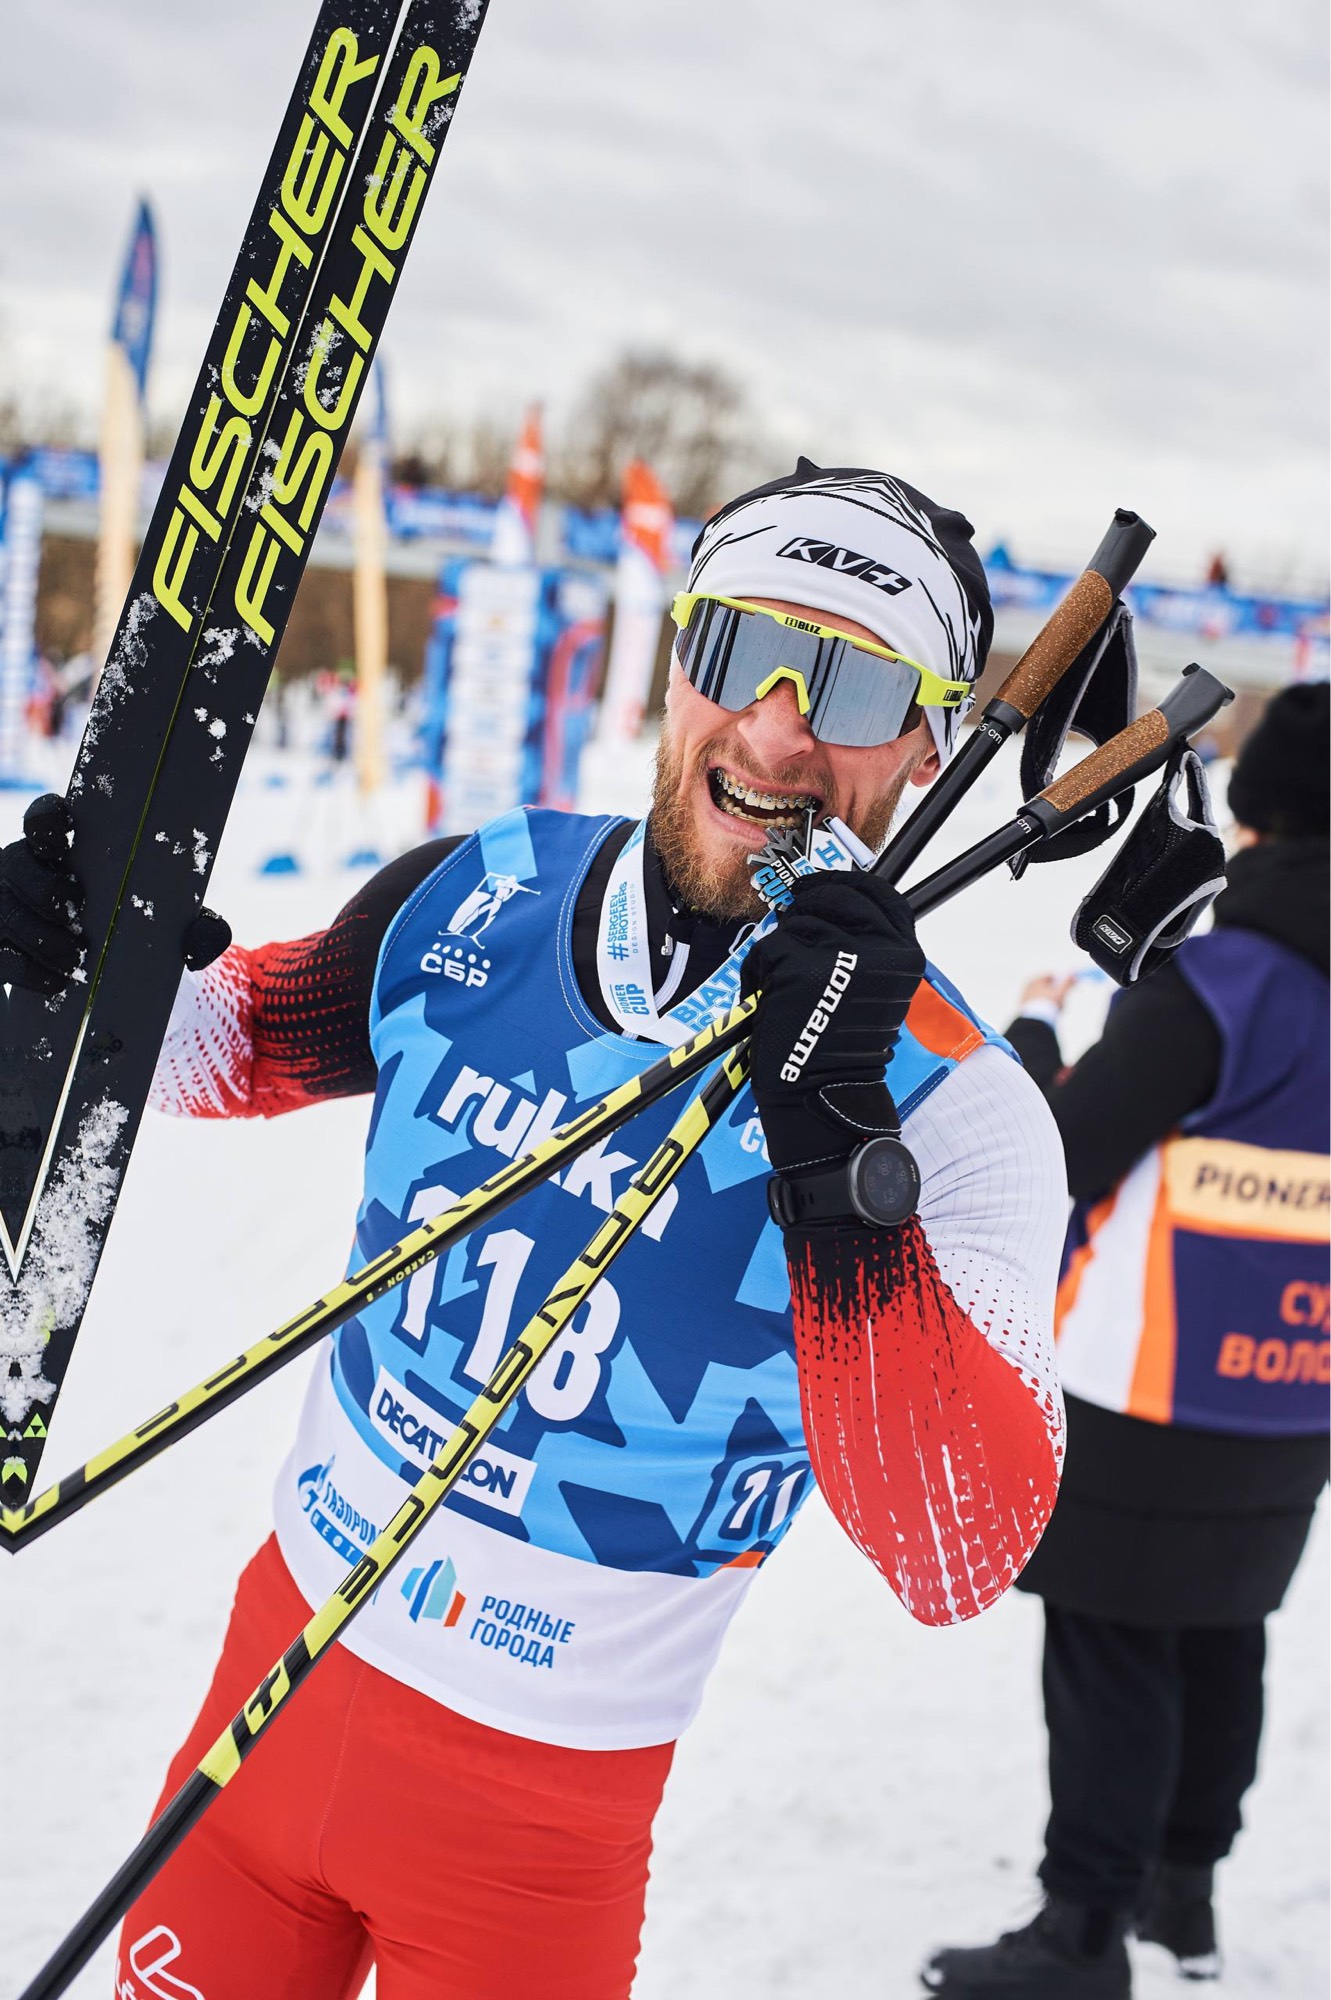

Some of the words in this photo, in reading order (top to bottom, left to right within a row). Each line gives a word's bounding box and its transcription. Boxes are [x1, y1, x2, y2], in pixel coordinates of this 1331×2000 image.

[153, 27, 379, 633] FISCHER
[235, 45, 462, 646] FISCHER
[797, 617, 822, 635] BLIZ
[988, 727, 1003, 744] cm
[1016, 818, 1032, 834] cm
[771, 860, 797, 890] PION
[617, 881, 629, 944] BROTHERS
[420, 952, 489, 988] СБР
[666, 935, 757, 1026] BIATH
[615, 984, 632, 1014] PIONER
[626, 983, 650, 1015] CUP
[780, 950, 857, 1083] noname
[387, 1250, 435, 1287] CARBON
[401, 1184, 621, 1422] 118
[1280, 1280, 1330, 1333] СУ
[377, 1387, 517, 1498] DECATON
[470, 1618, 554, 1669] ГОРОДА
[481, 1595, 576, 1643] РОДНЫЕ
